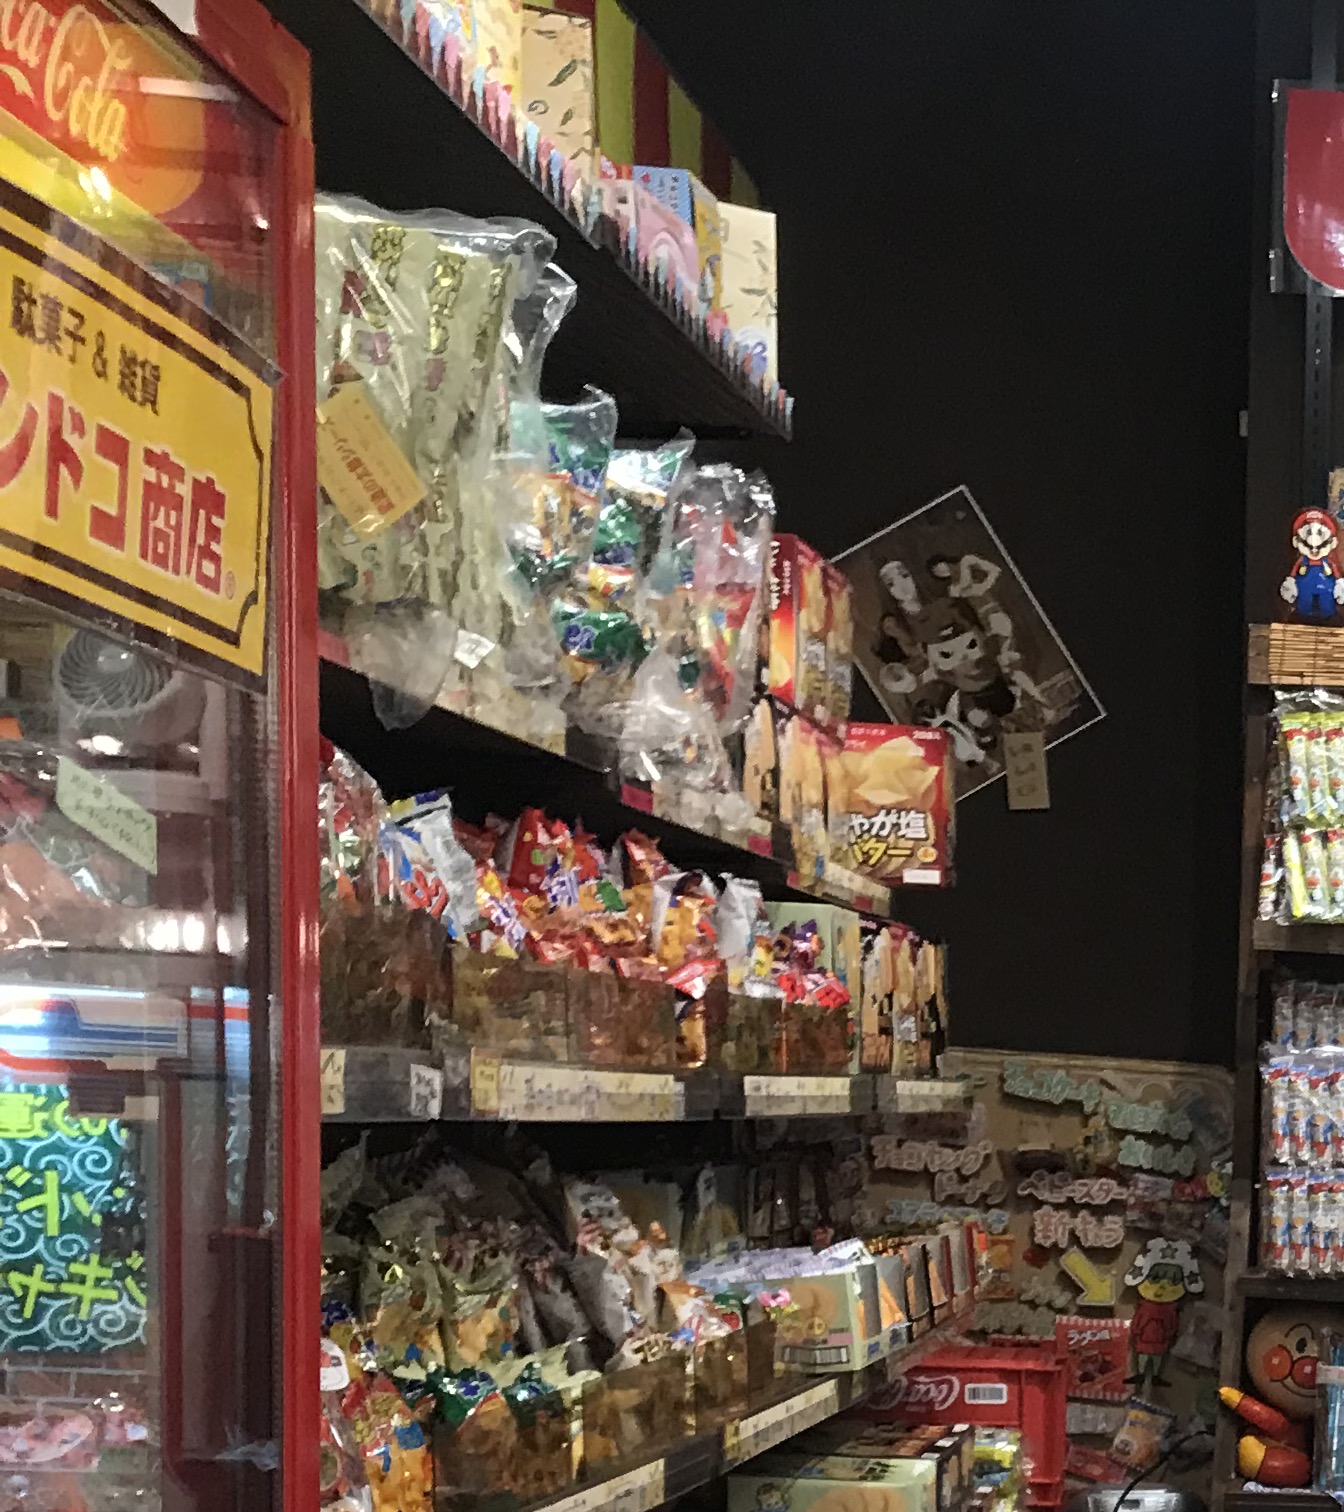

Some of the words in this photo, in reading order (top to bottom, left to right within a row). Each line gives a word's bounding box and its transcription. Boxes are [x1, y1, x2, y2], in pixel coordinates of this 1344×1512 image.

[9, 275, 88, 367] 駄菓子
[91, 330, 109, 381] &
[117, 341, 161, 417] 雑貨
[850, 808, 930, 839] ゃが塩
